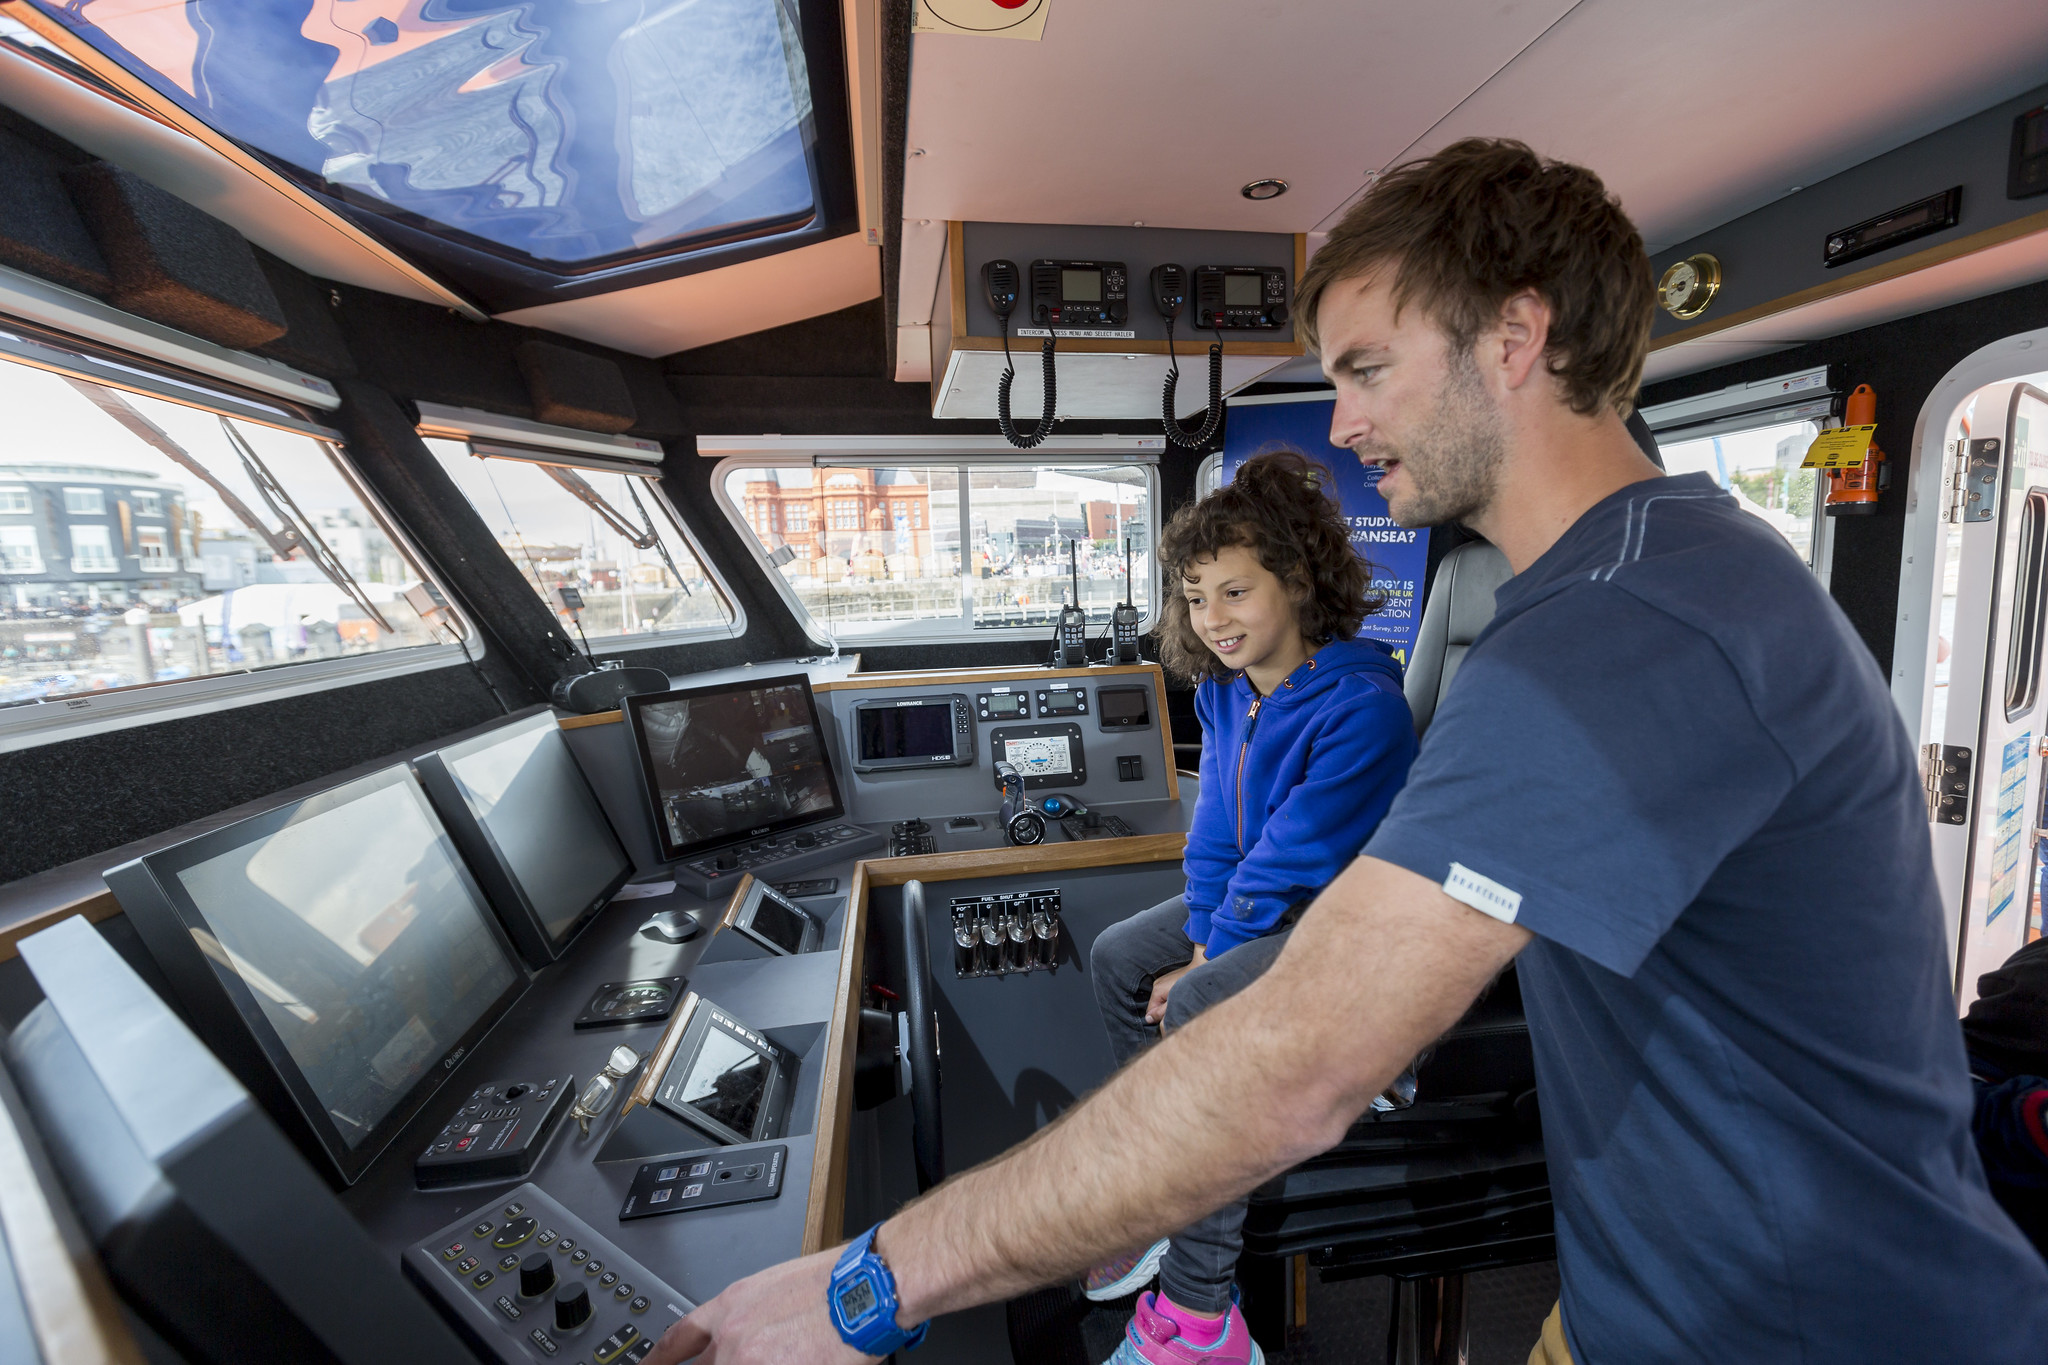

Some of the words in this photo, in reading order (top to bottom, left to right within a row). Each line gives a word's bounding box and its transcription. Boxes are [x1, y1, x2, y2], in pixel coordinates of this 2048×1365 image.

[1355, 516, 1400, 527] STUDY
[1348, 530, 1416, 543] WANSEA?
[1404, 581, 1414, 590] IS
[1387, 598, 1413, 607] DENT
